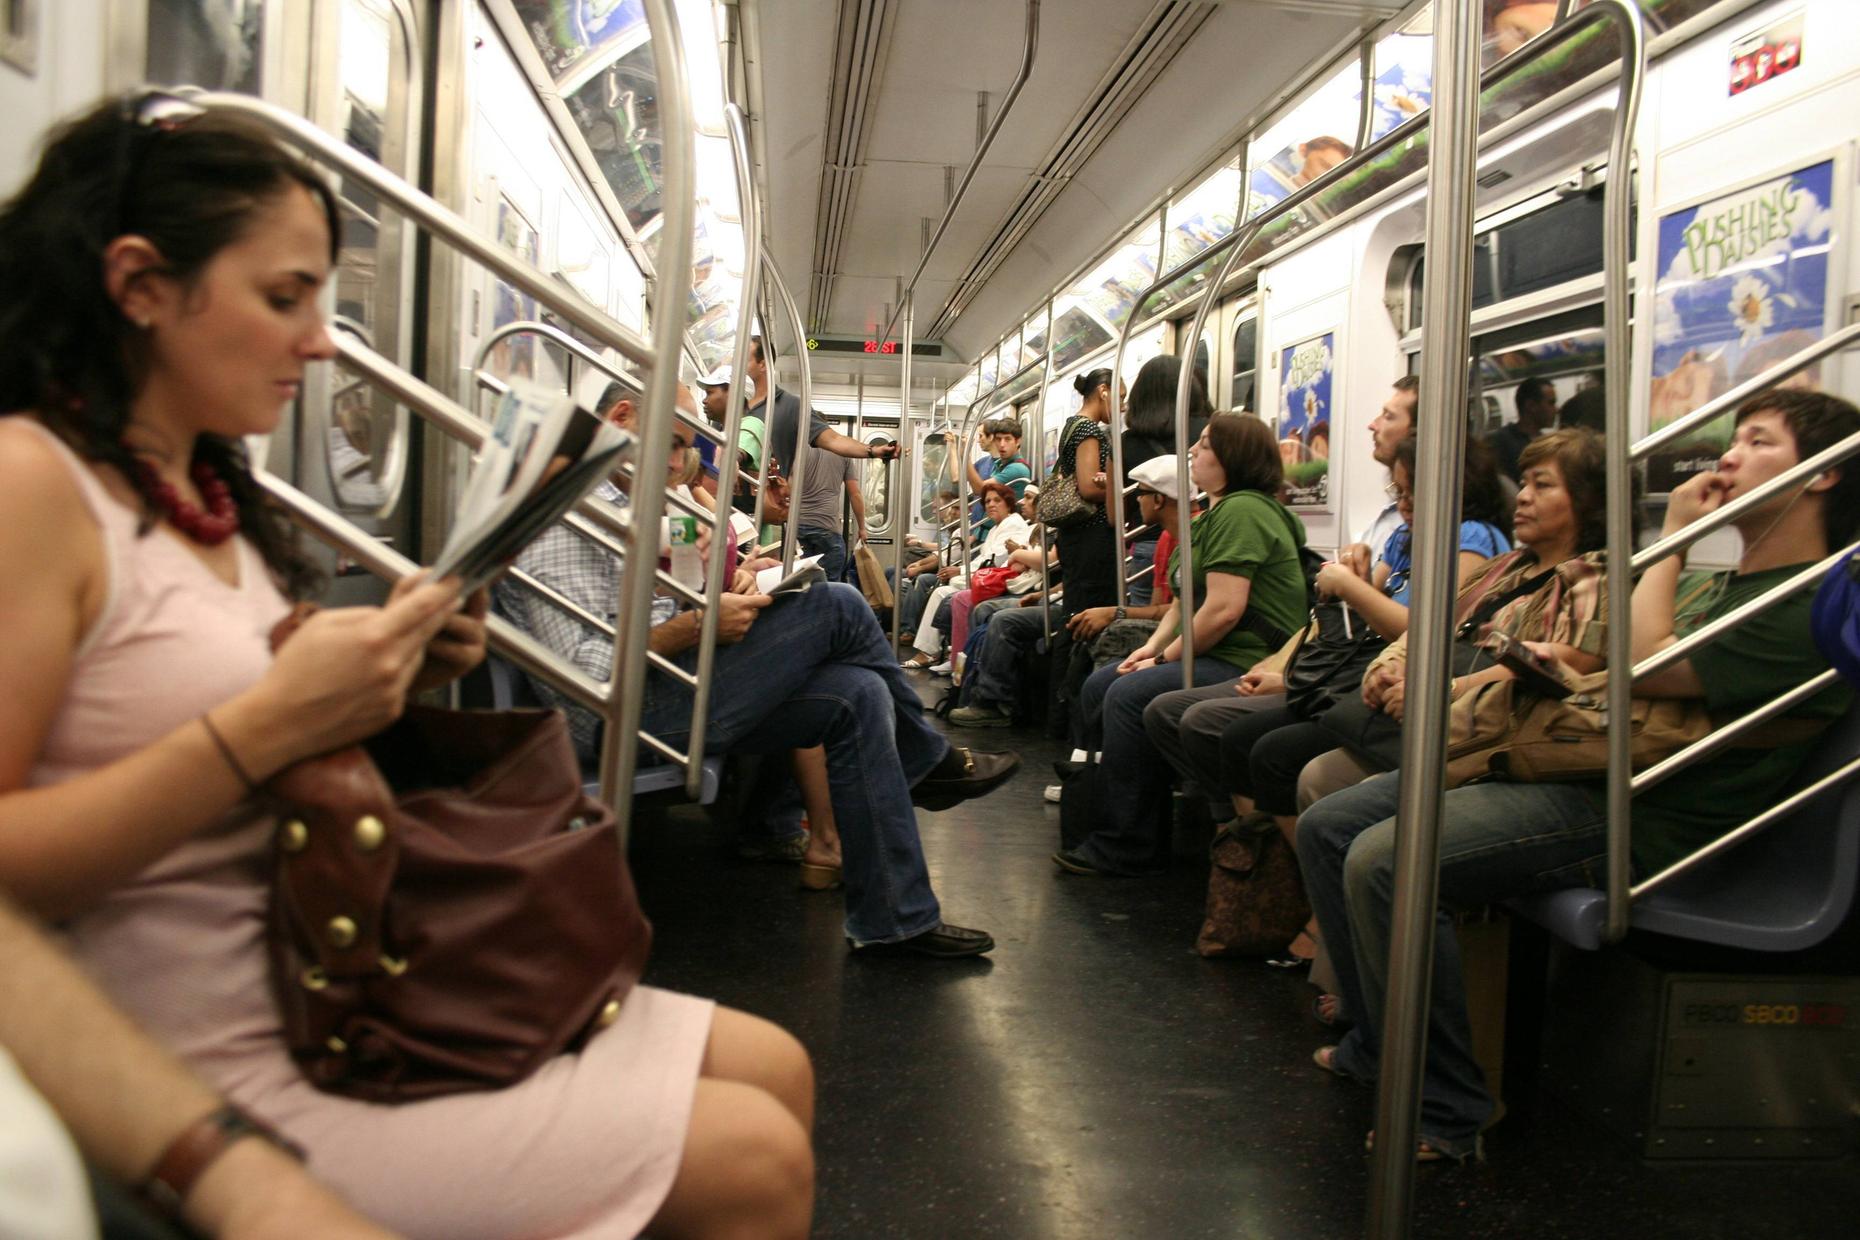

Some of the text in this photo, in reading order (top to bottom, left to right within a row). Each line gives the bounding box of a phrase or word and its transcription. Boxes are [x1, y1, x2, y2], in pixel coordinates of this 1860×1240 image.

[1684, 179, 1798, 274] PUSHING
[1701, 219, 1792, 280] DAISIES
[882, 341, 896, 354] ST
